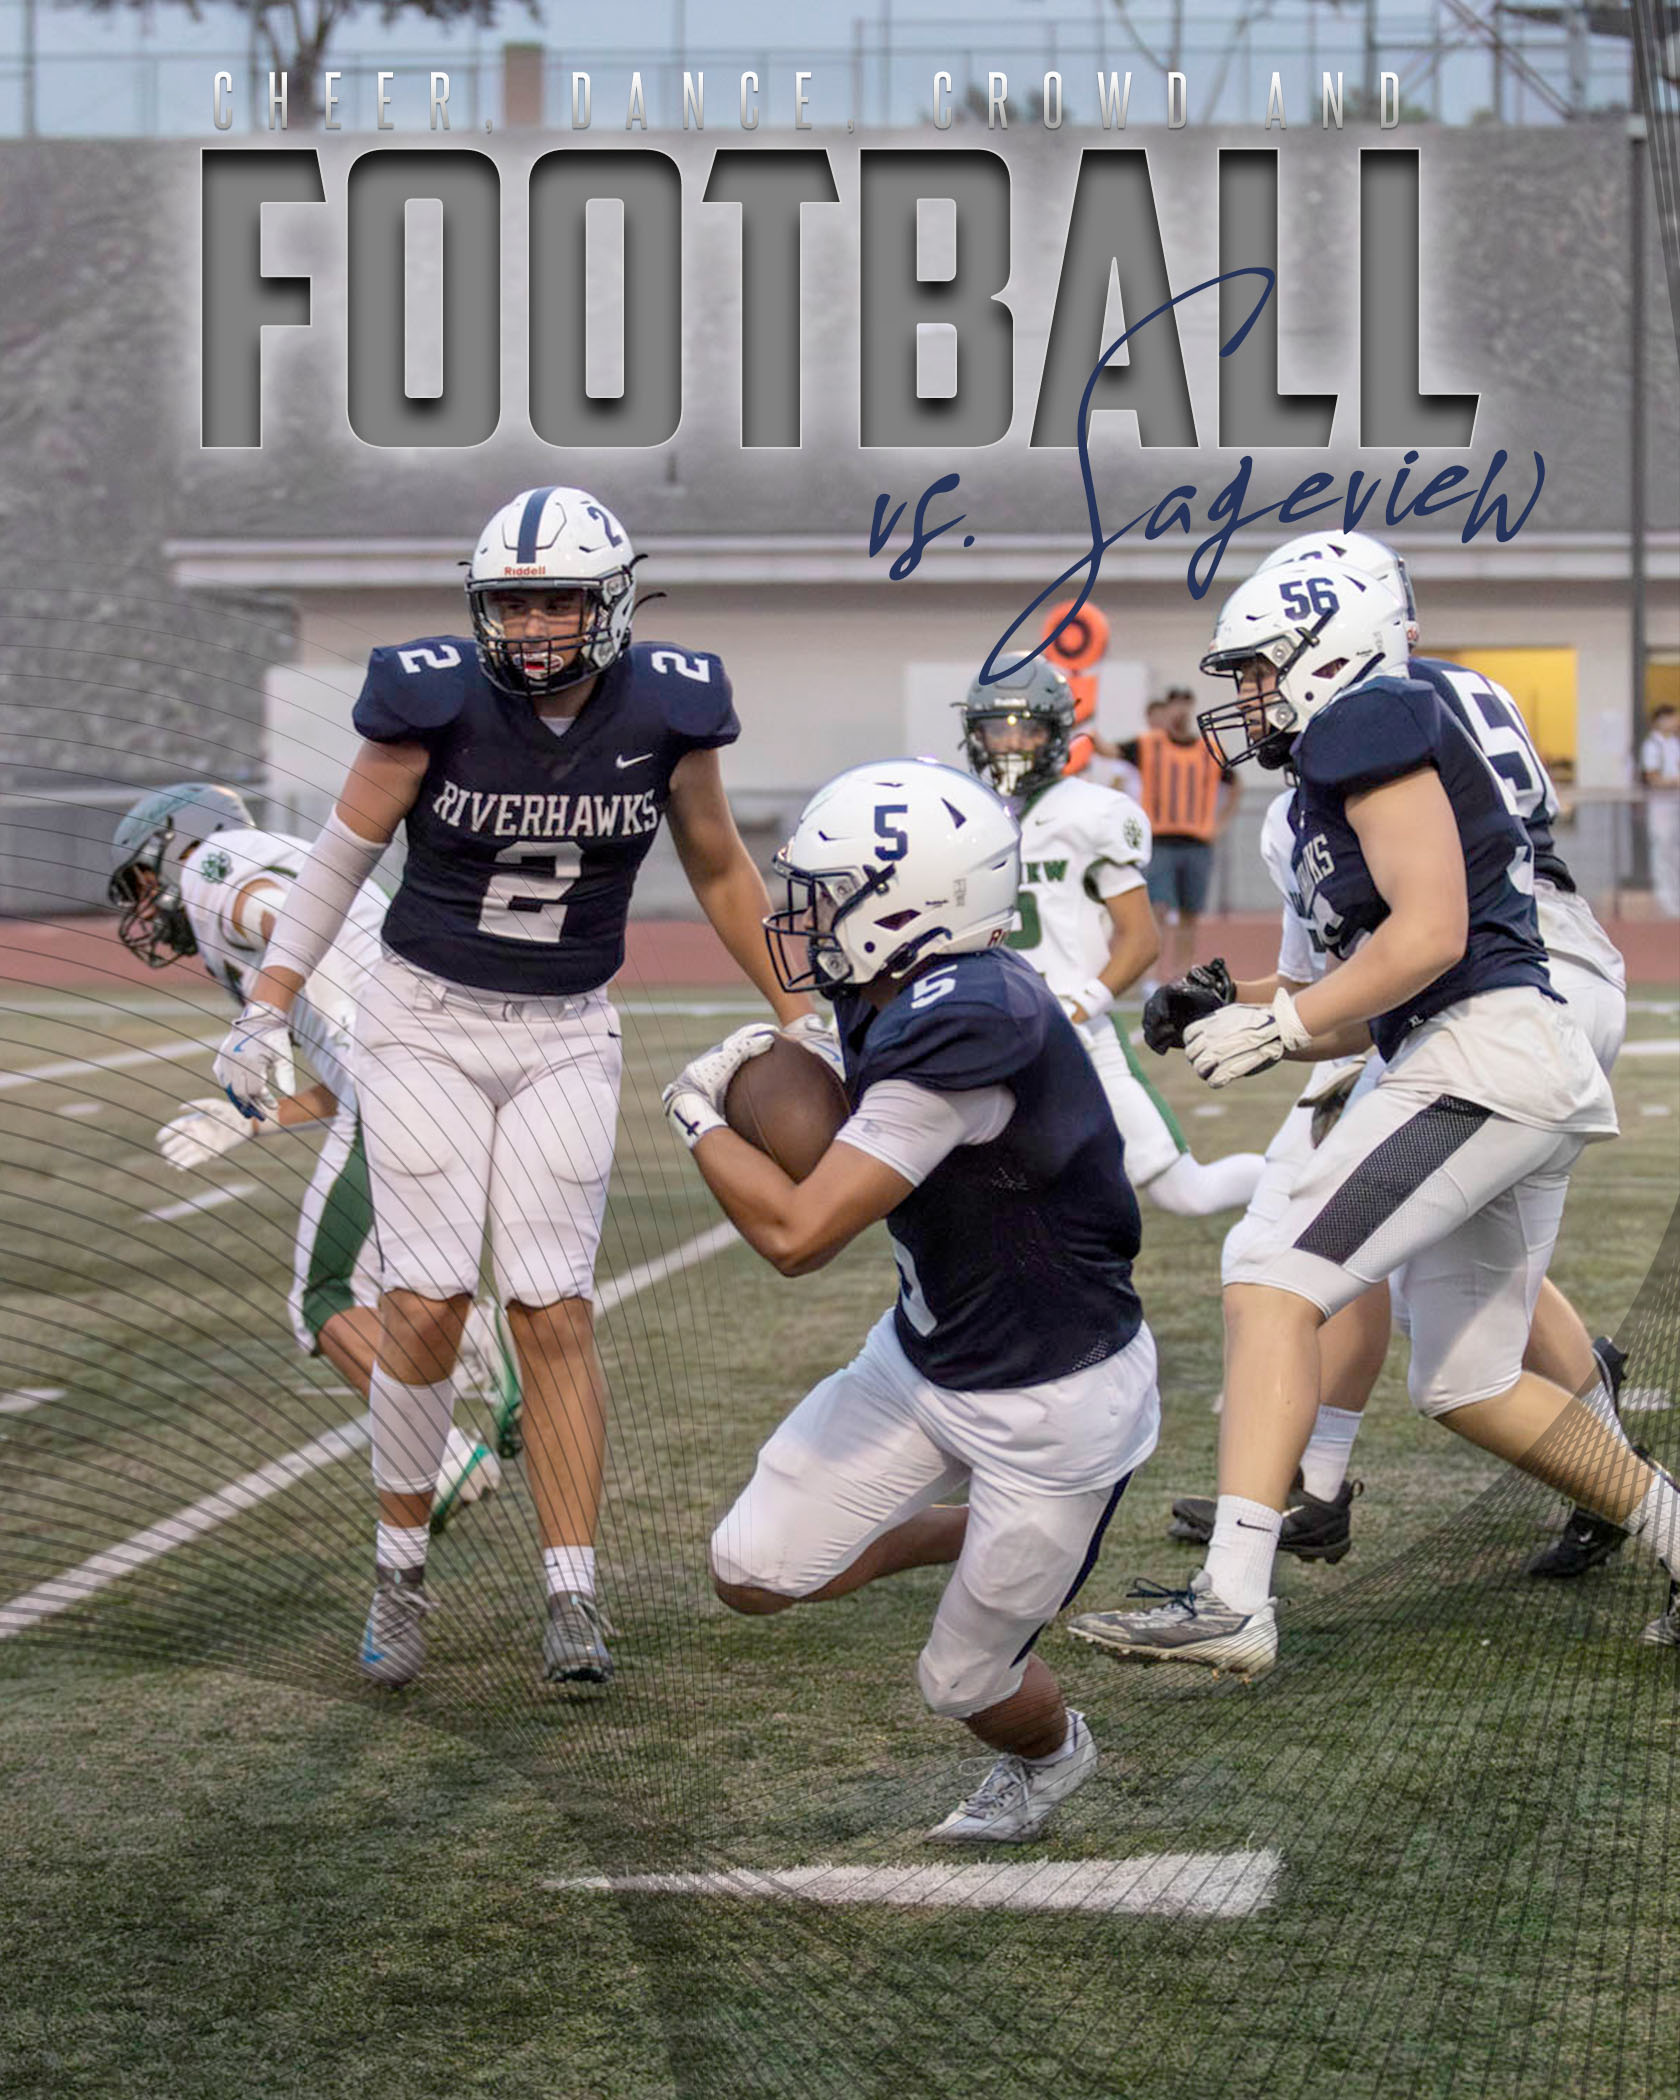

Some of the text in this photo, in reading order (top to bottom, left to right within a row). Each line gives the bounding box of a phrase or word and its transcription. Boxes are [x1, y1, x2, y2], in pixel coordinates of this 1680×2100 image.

[587, 505, 623, 549] 2
[503, 565, 547, 577] Riddell
[1279, 577, 1341, 622] 56
[397, 644, 462, 675] 2
[651, 650, 711, 684] 2
[433, 779, 659, 838] RIVERHAWKS
[874, 804, 909, 862] 5
[477, 841, 585, 943] 2
[911, 964, 958, 1010] 5
